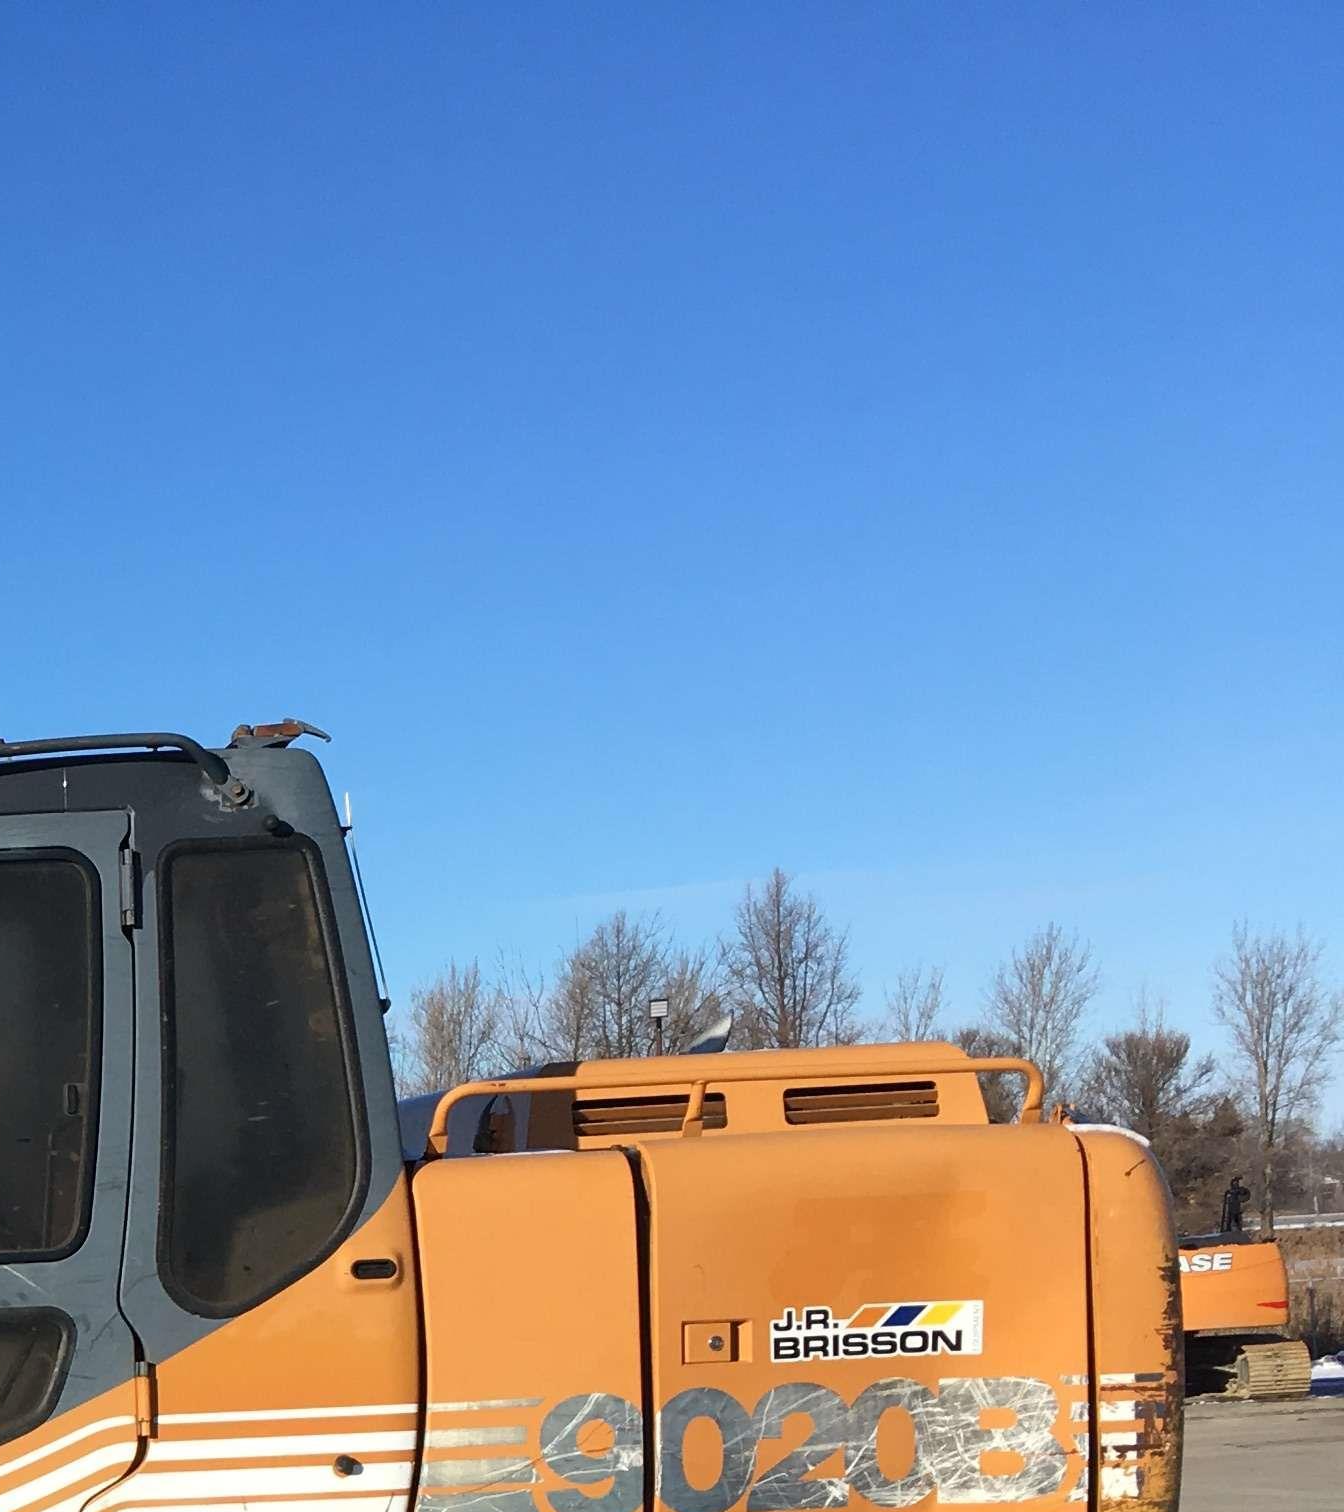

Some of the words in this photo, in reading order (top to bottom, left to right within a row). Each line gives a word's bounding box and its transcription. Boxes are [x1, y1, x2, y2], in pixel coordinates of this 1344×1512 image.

[1178, 1252, 1233, 1273] ASE
[773, 1309, 839, 1332] J.R.
[773, 1329, 963, 1360] BRISSON
